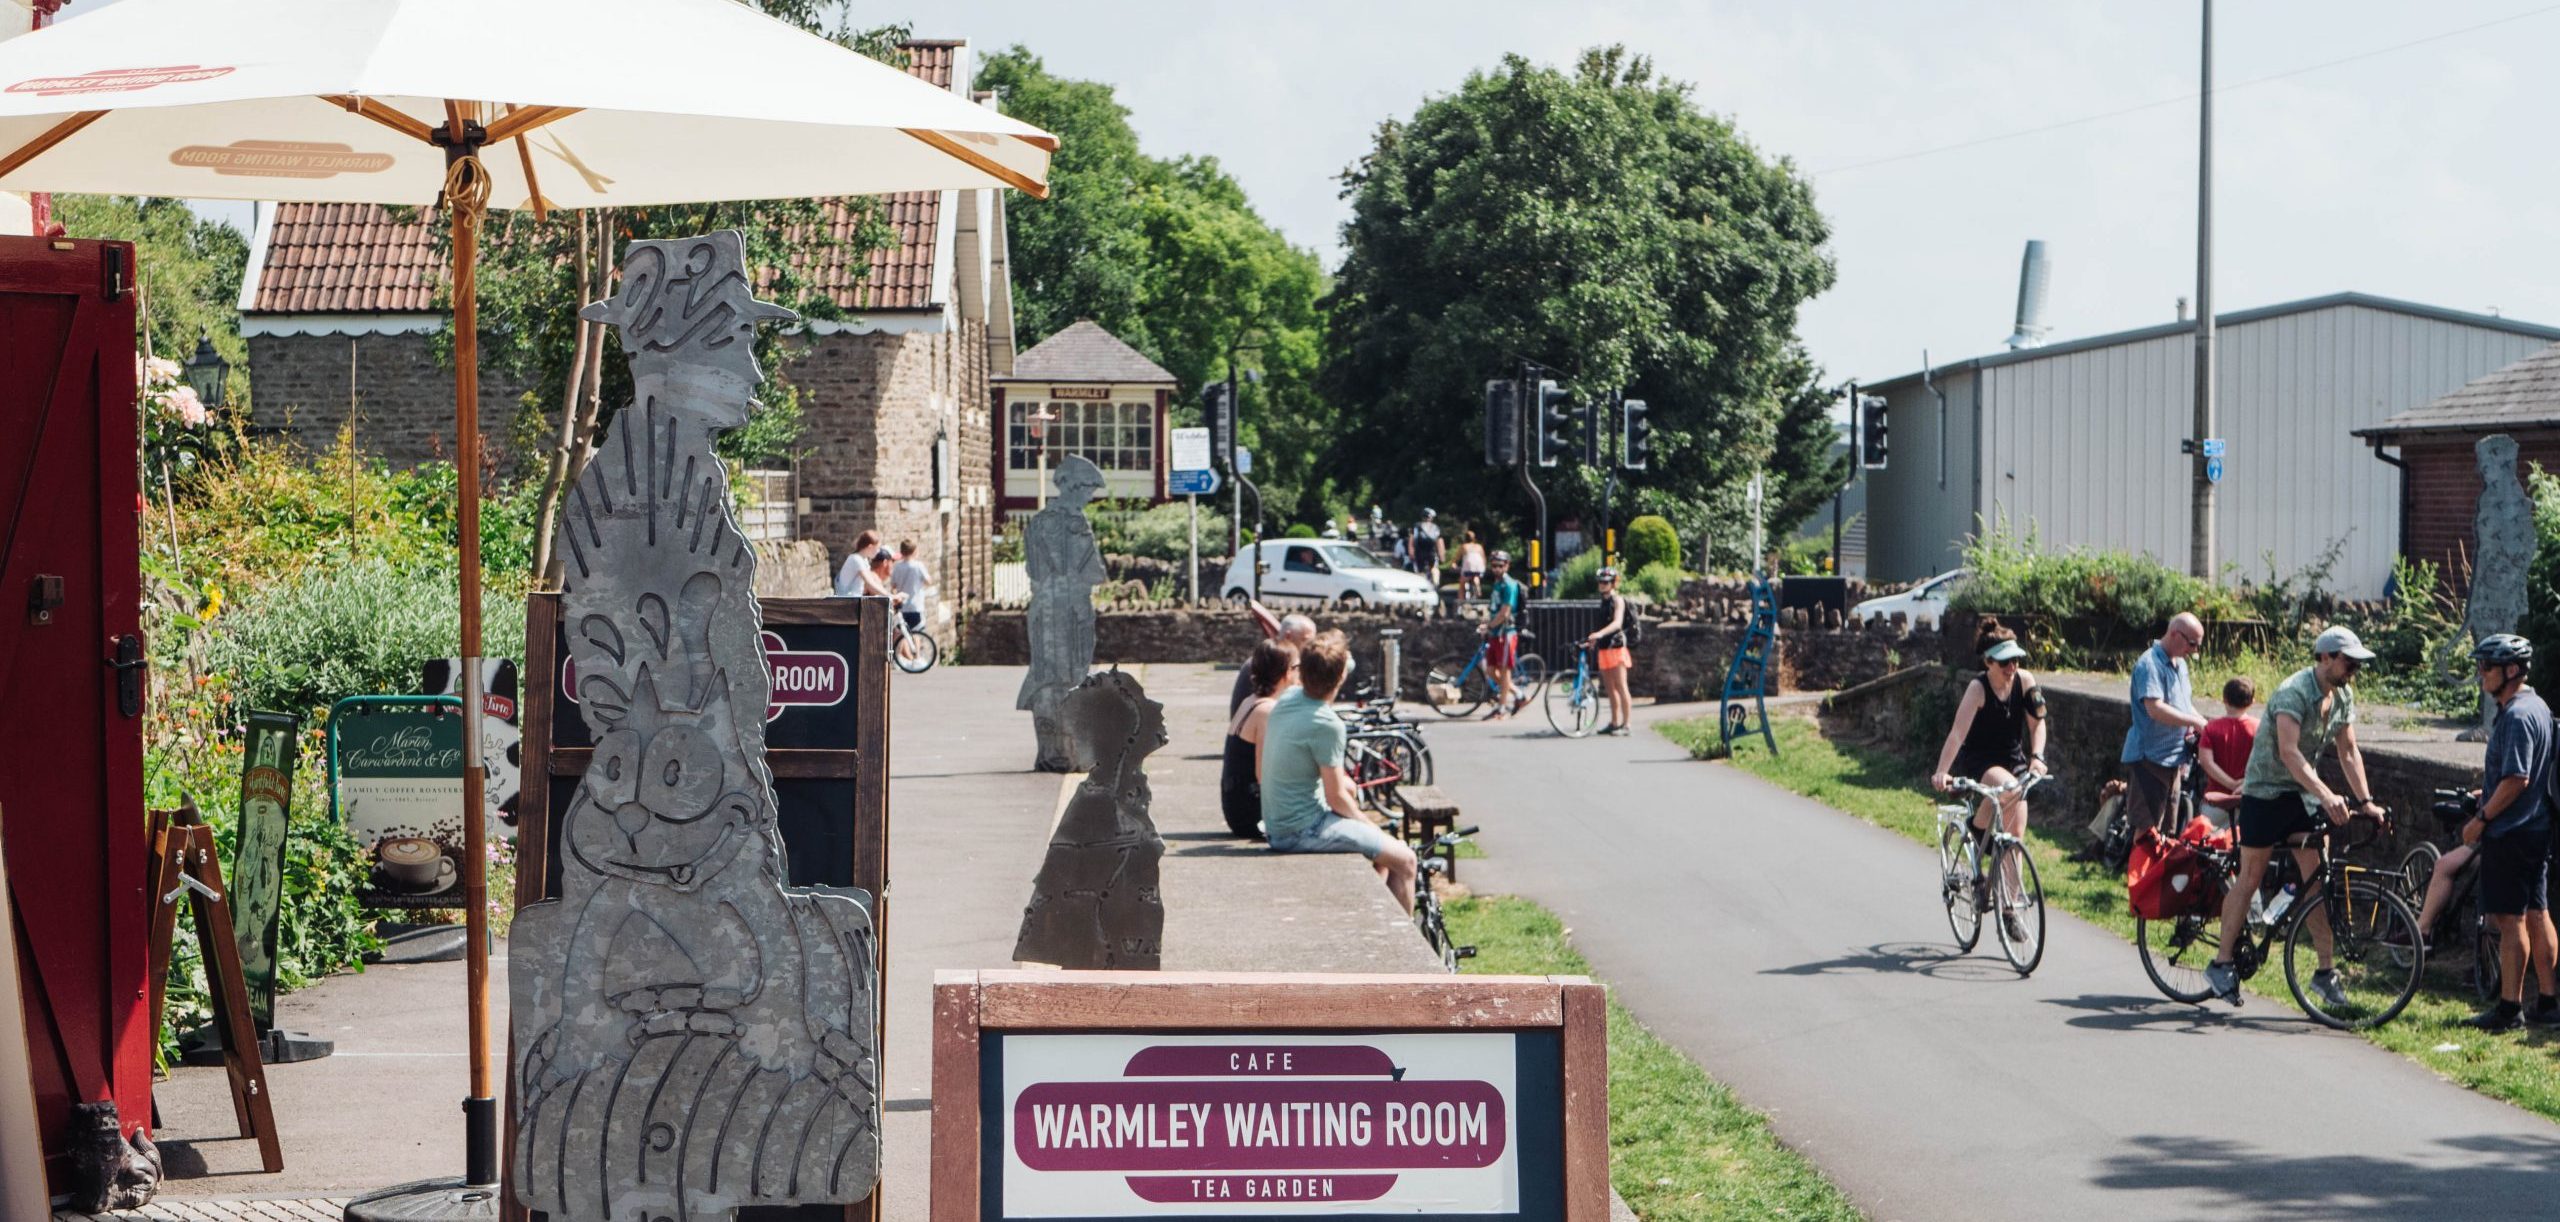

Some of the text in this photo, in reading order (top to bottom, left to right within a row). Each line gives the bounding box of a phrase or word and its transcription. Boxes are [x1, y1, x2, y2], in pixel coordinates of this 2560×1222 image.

[1056, 389, 1106, 398] WARMLEY
[776, 666, 834, 691] ROOM
[371, 726, 432, 754] Martin
[425, 752, 438, 767] &
[1230, 1052, 1292, 1070] CAFE
[1032, 1101, 1488, 1149] WARMLEY WAITING ROOM
[1191, 1178, 1333, 1198] TEA GARDEN
